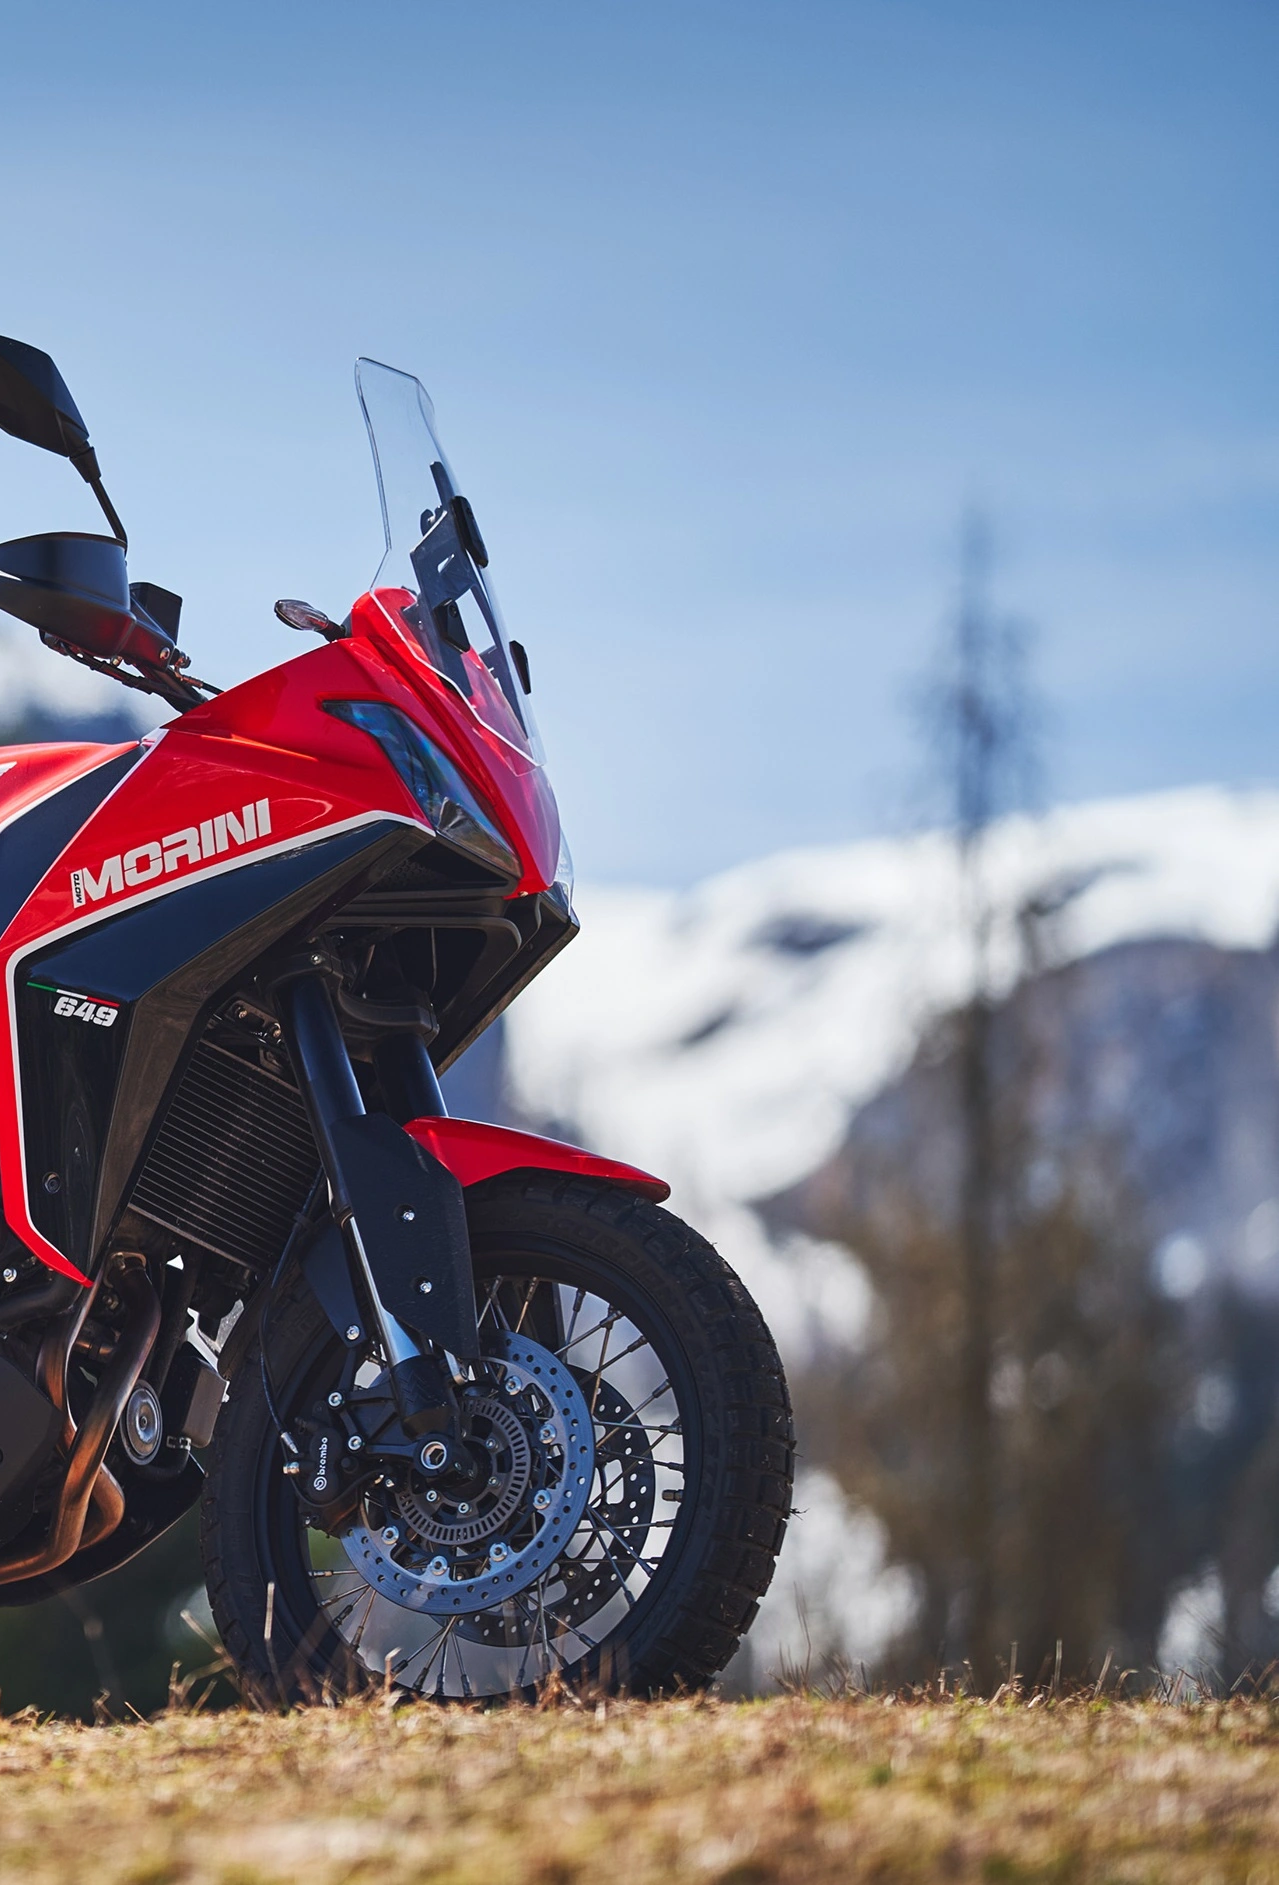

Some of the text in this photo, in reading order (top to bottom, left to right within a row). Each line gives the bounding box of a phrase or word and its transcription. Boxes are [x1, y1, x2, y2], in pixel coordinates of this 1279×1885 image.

[73, 798, 272, 904] MOTO MORINI
[53, 996, 118, 1028] 649
[316, 1437, 329, 1476] brembo
